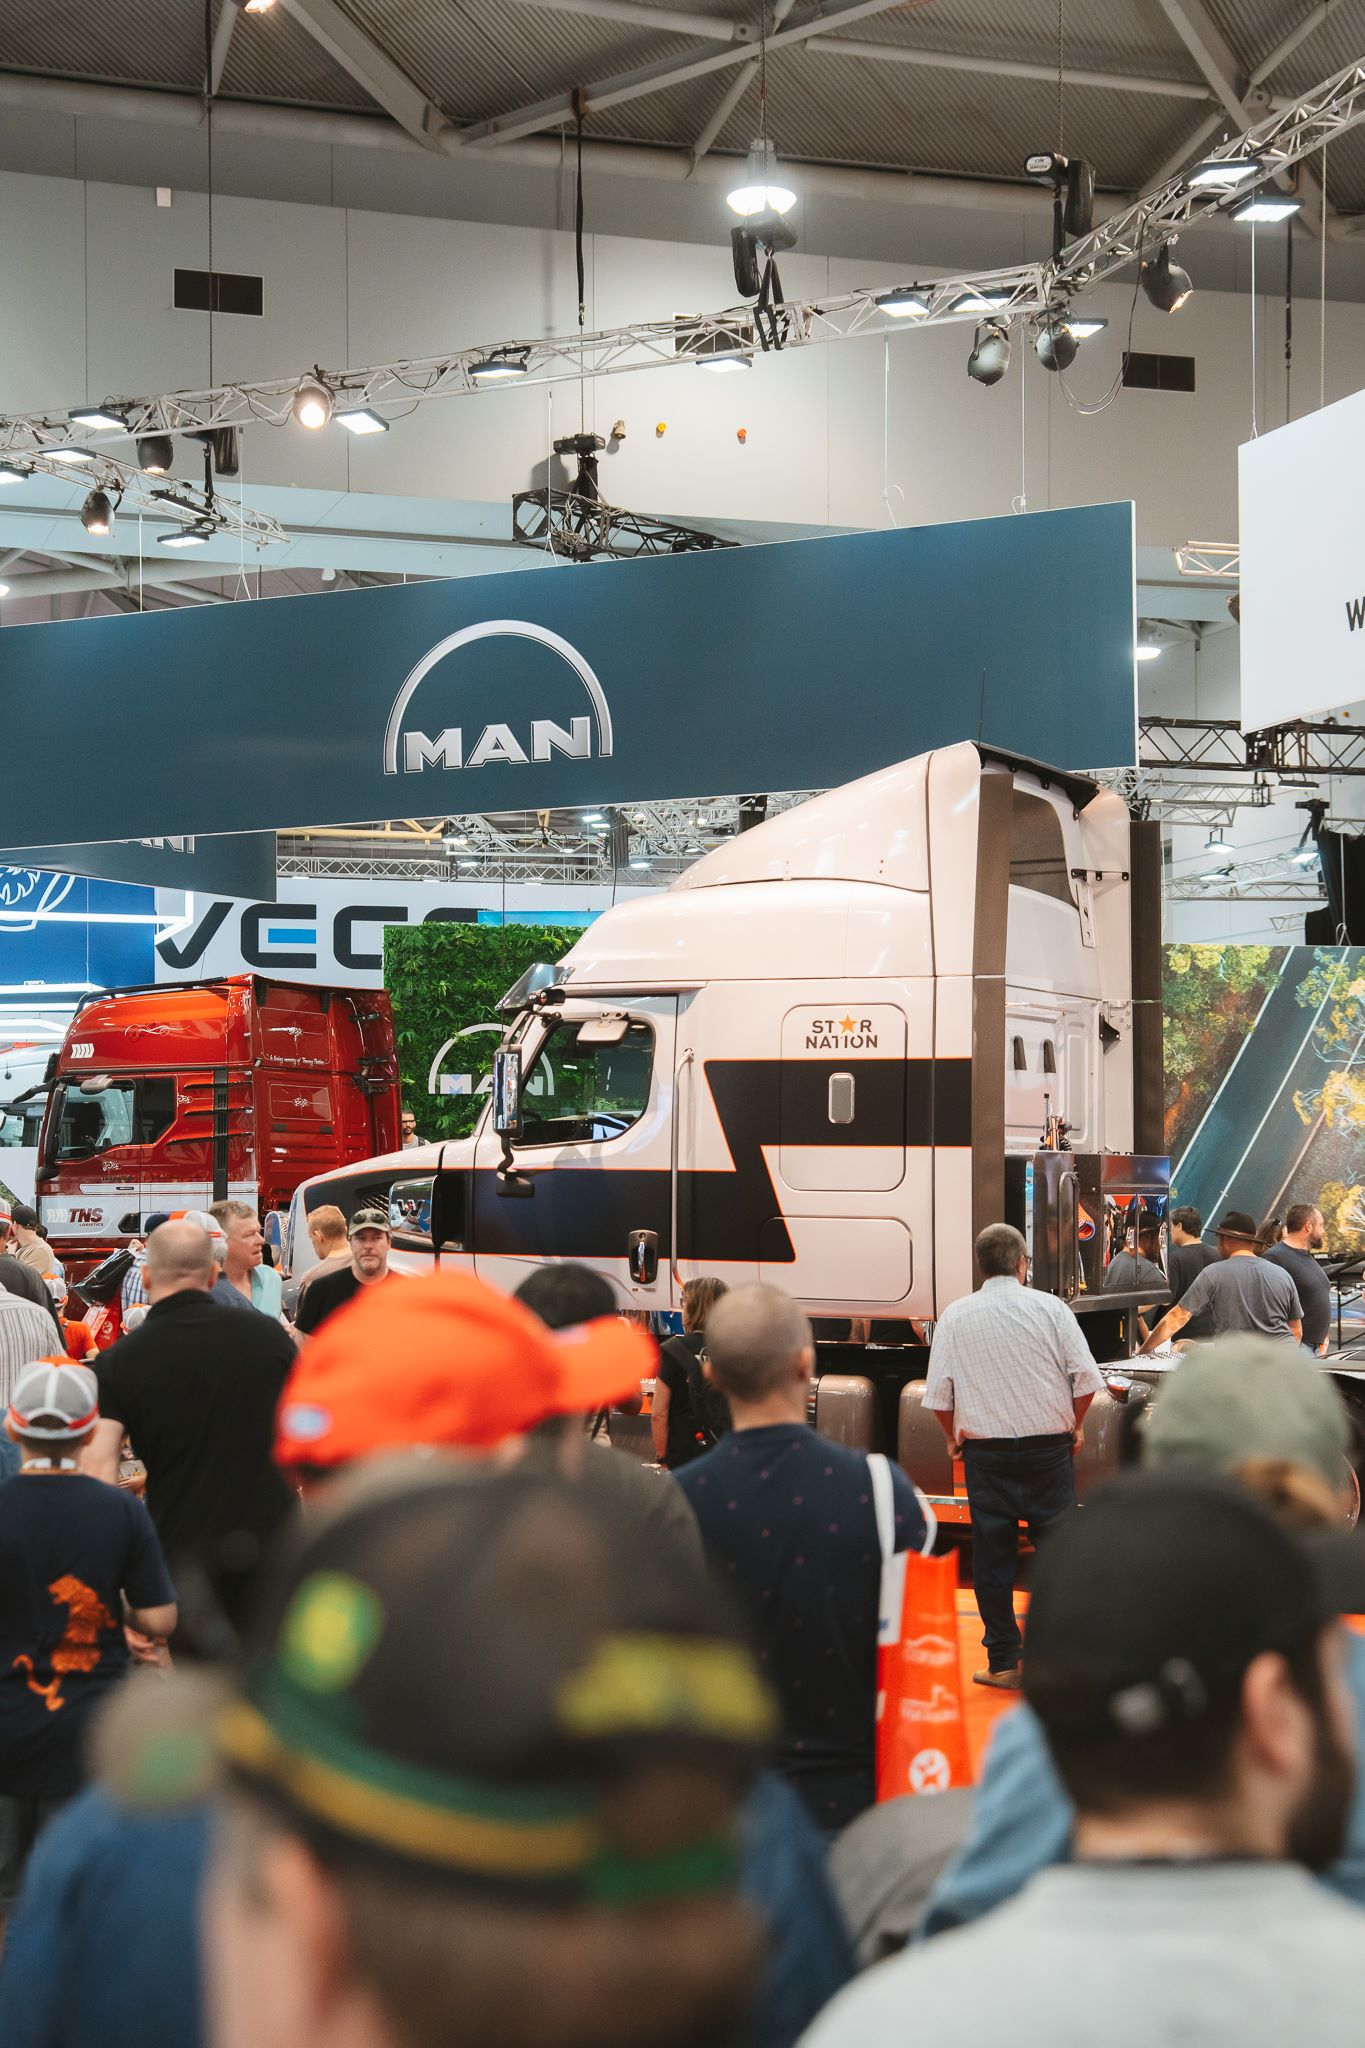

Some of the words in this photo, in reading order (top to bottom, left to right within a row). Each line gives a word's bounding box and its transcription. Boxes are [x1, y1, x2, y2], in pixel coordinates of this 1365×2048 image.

[404, 716, 591, 774] MAN
[154, 901, 479, 970] VEC
[806, 1035, 878, 1049] NATION
[69, 1208, 103, 1222] TNS
